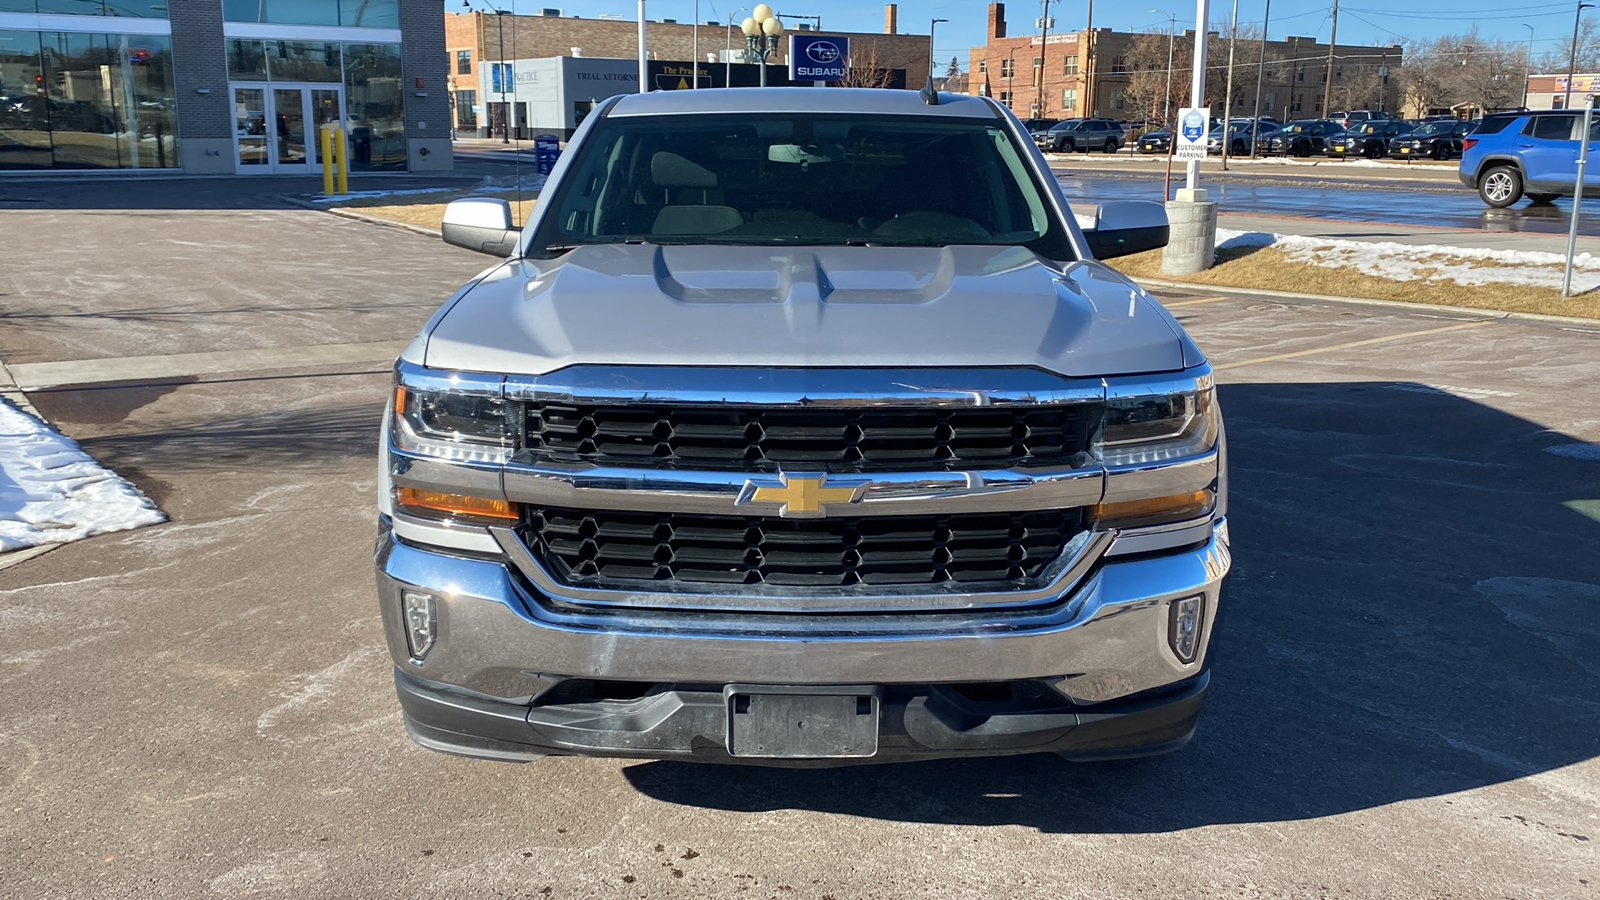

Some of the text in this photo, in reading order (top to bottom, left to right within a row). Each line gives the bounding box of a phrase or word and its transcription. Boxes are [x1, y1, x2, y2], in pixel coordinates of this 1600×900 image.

[662, 66, 709, 76] The Pracice
[797, 66, 846, 76] SUBARU
[576, 72, 640, 82] TRIAL ATTORNE
